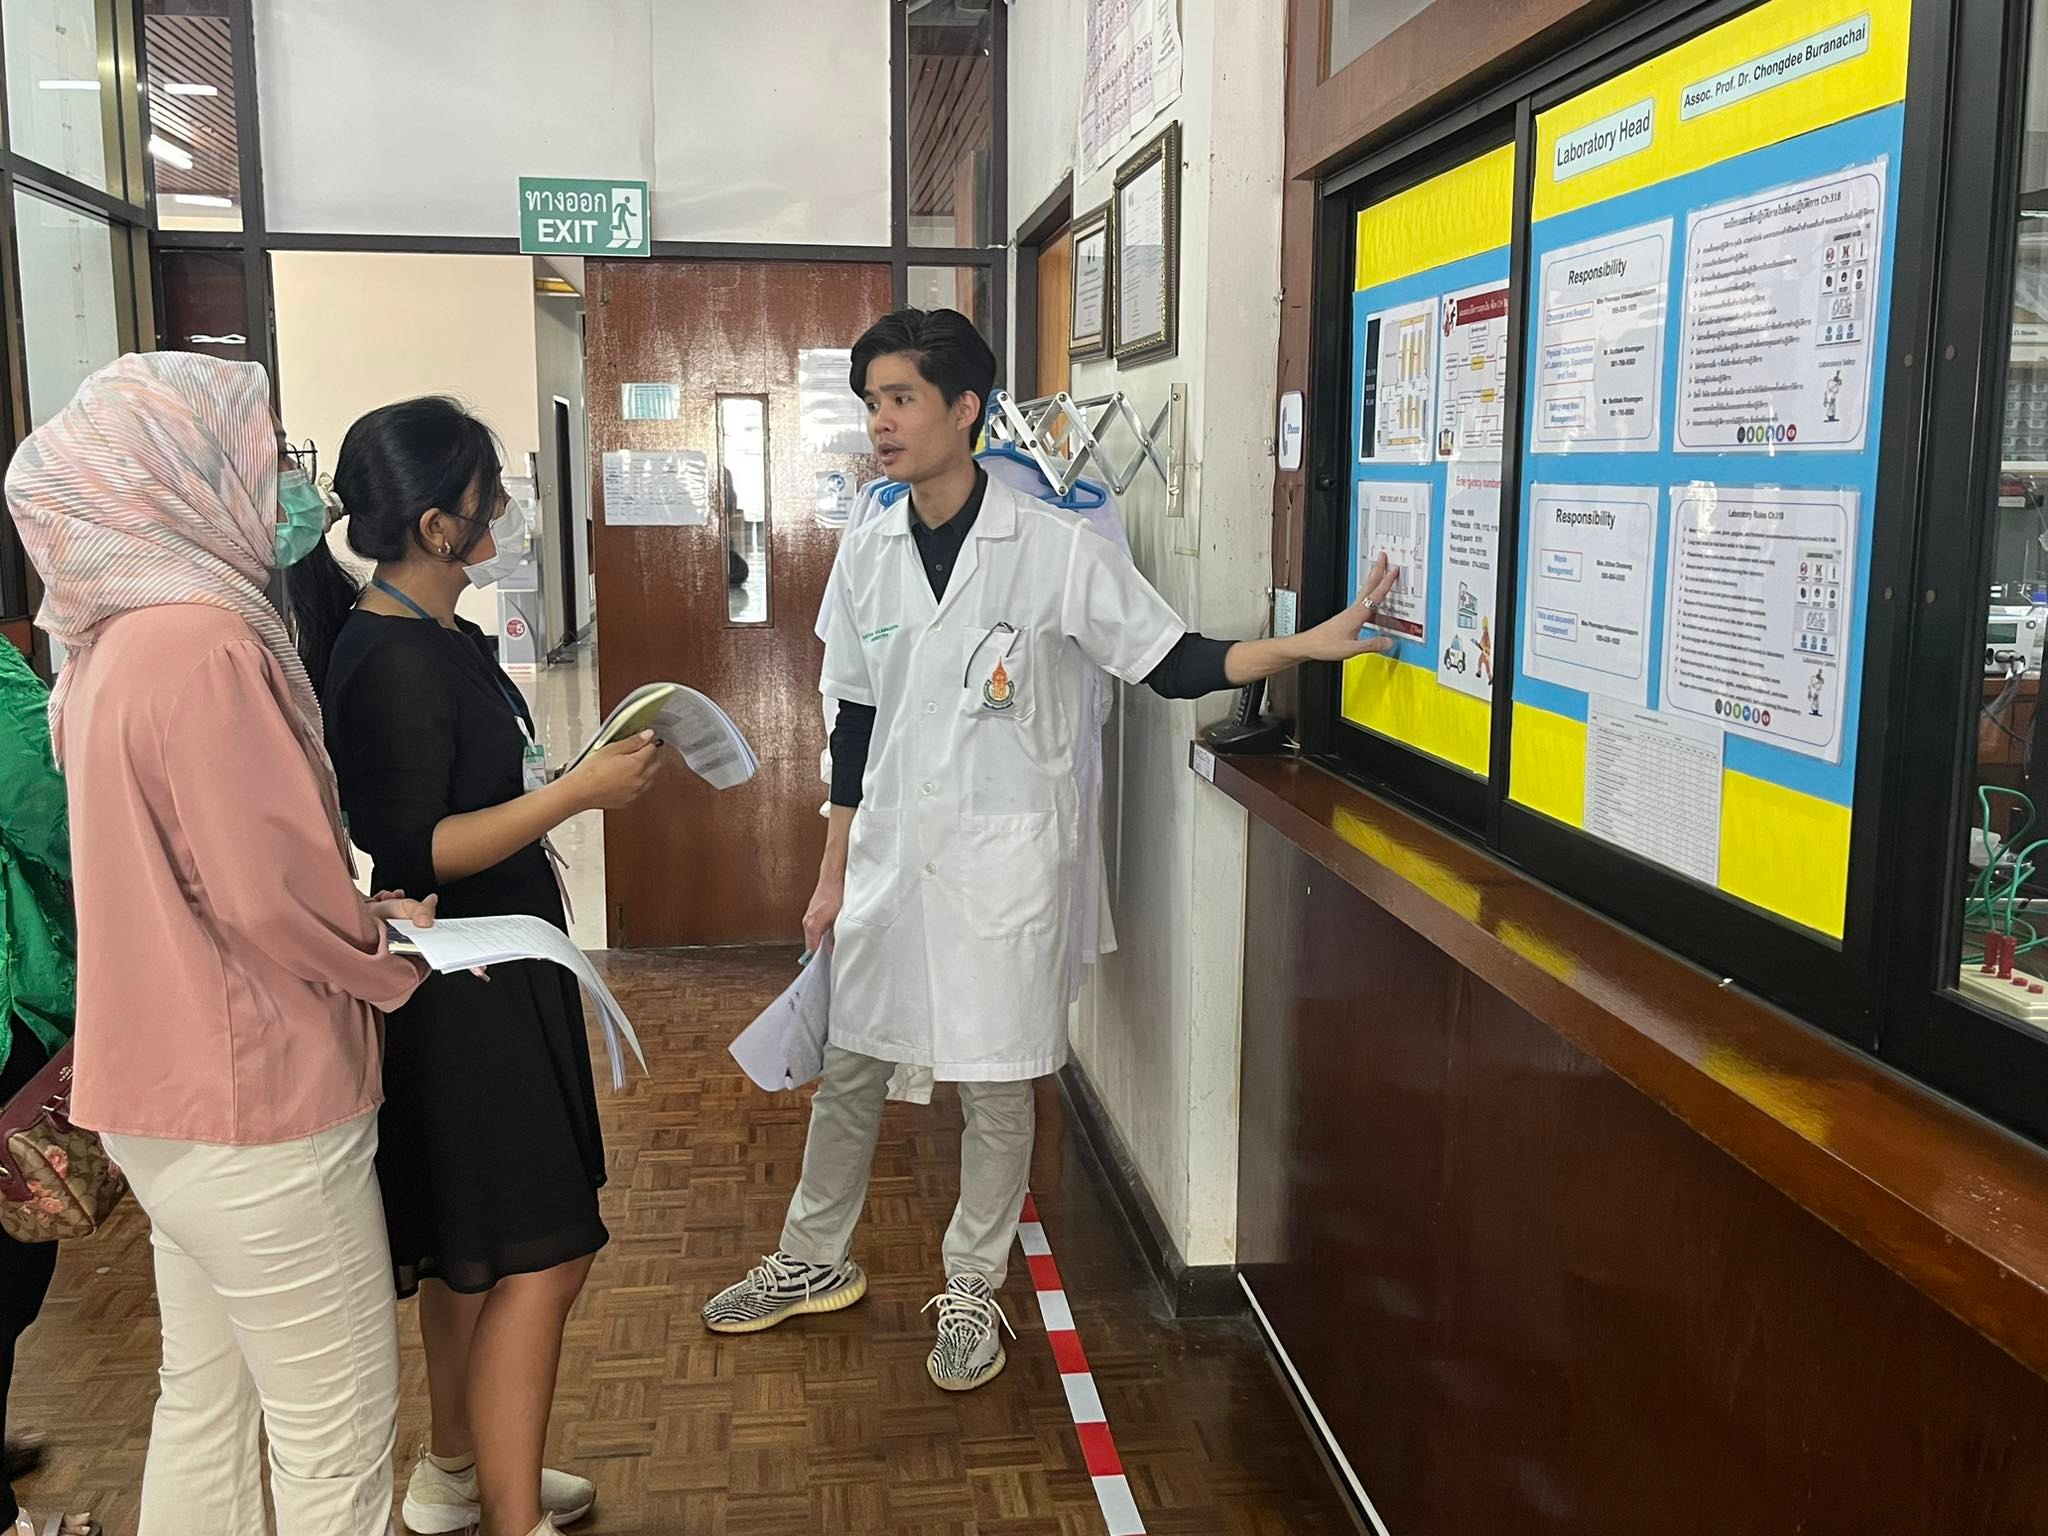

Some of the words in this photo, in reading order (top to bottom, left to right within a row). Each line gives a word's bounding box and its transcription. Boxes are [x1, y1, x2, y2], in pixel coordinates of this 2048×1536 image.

[1684, 90, 1713, 108] Assoc.
[1715, 76, 1736, 97] Prof.
[1738, 72, 1751, 87] Dr.
[1753, 52, 1803, 81] Chongdee
[1805, 23, 1866, 61] Buranachai
[1557, 129, 1617, 167] Laboratory
[1619, 108, 1651, 142] Head
[525, 190, 607, 213] ทางออก
[538, 218, 599, 244] EXIT
[1568, 258, 1627, 286] Responsibility
[1556, 508, 1616, 530] Responsibility
